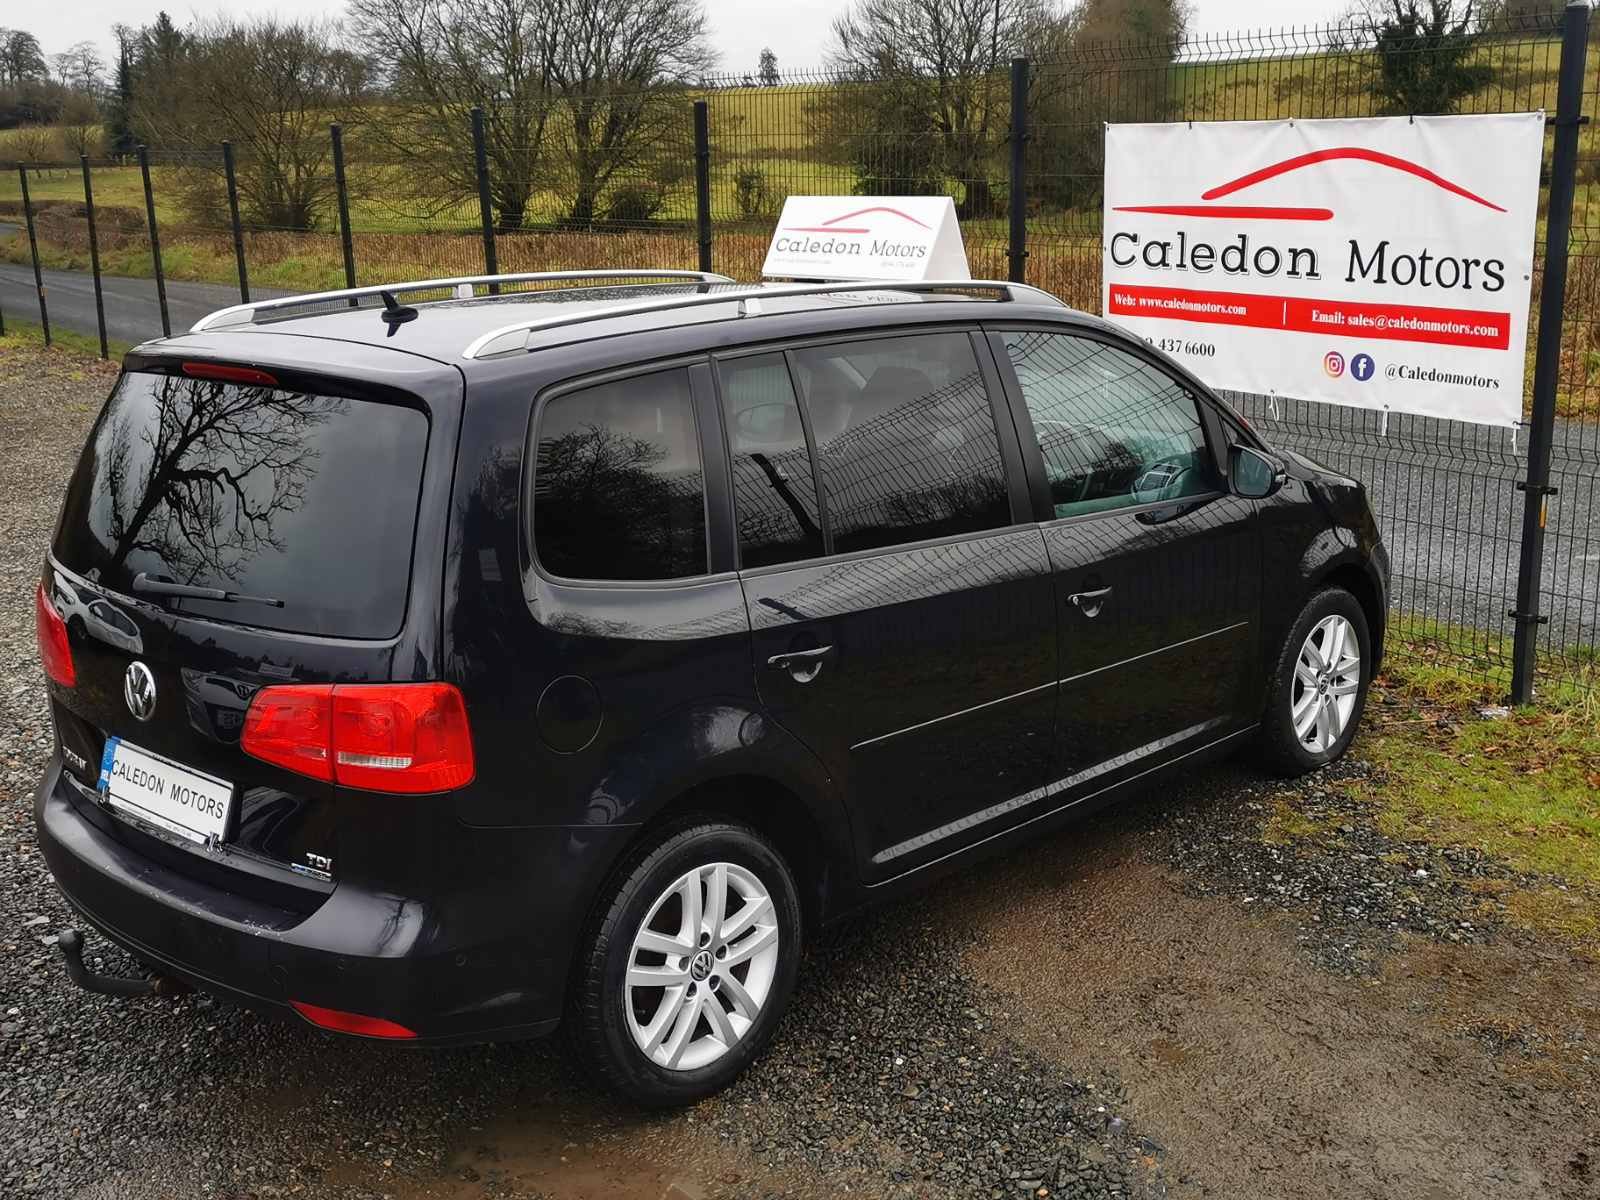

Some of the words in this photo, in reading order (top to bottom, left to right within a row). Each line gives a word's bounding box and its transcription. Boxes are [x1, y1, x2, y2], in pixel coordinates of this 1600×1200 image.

[776, 238, 861, 255] Caledon
[869, 240, 927, 258] Motors
[1111, 231, 1321, 280] Caledon
[1345, 239, 1505, 292] Motors
[1114, 293, 1136, 306] Web:
[1138, 296, 1247, 316] www.caledonmotors.com
[1311, 309, 1345, 325] Email:
[1347, 313, 1499, 337] sales@caledonmotors.com
[1158, 338, 1182, 353] 437
[1184, 341, 1216, 358] 6600
[1384, 363, 1500, 389] @Caledonmotors
[111, 759, 165, 795] CALEDON
[170, 783, 224, 819] MOTORS
[306, 852, 332, 870] TDI
